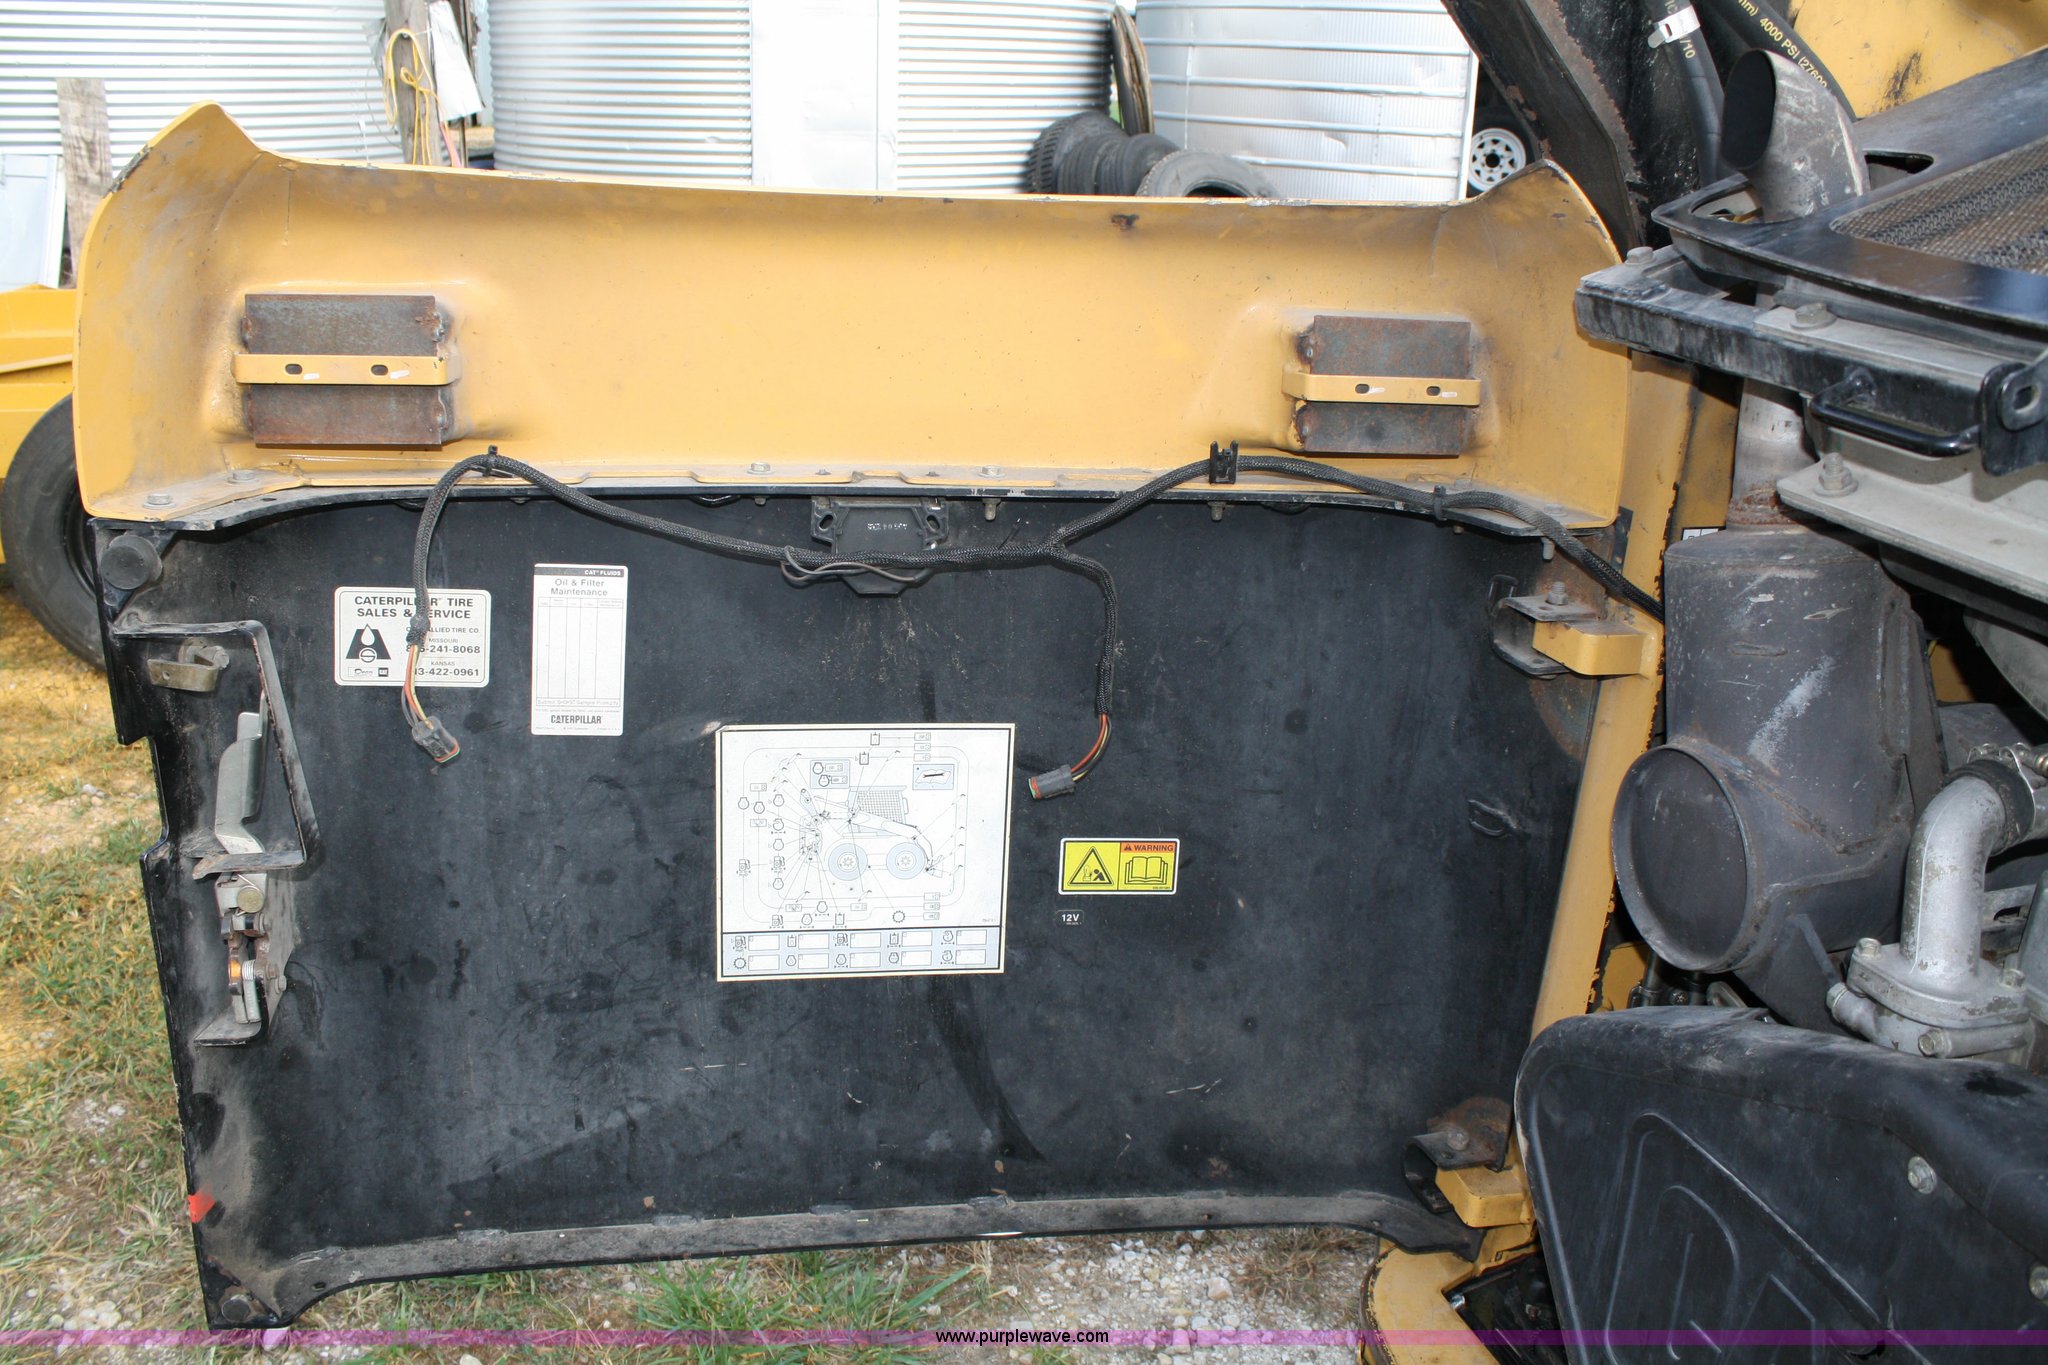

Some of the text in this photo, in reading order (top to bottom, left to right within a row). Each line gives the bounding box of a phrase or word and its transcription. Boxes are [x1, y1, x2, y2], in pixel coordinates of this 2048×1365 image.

[1760, 18, 1783, 42] 4000
[1781, 38, 1800, 59] PSI
[555, 578, 568, 586] Oil
[581, 579, 604, 587] Filter
[551, 588, 608, 596] Maintenance
[354, 596, 474, 607] CATERPILR TIRE
[357, 608, 471, 619] SALES & ERVICE
[551, 714, 602, 724] CATERPILLAR
[1061, 914, 1080, 922] 12V
